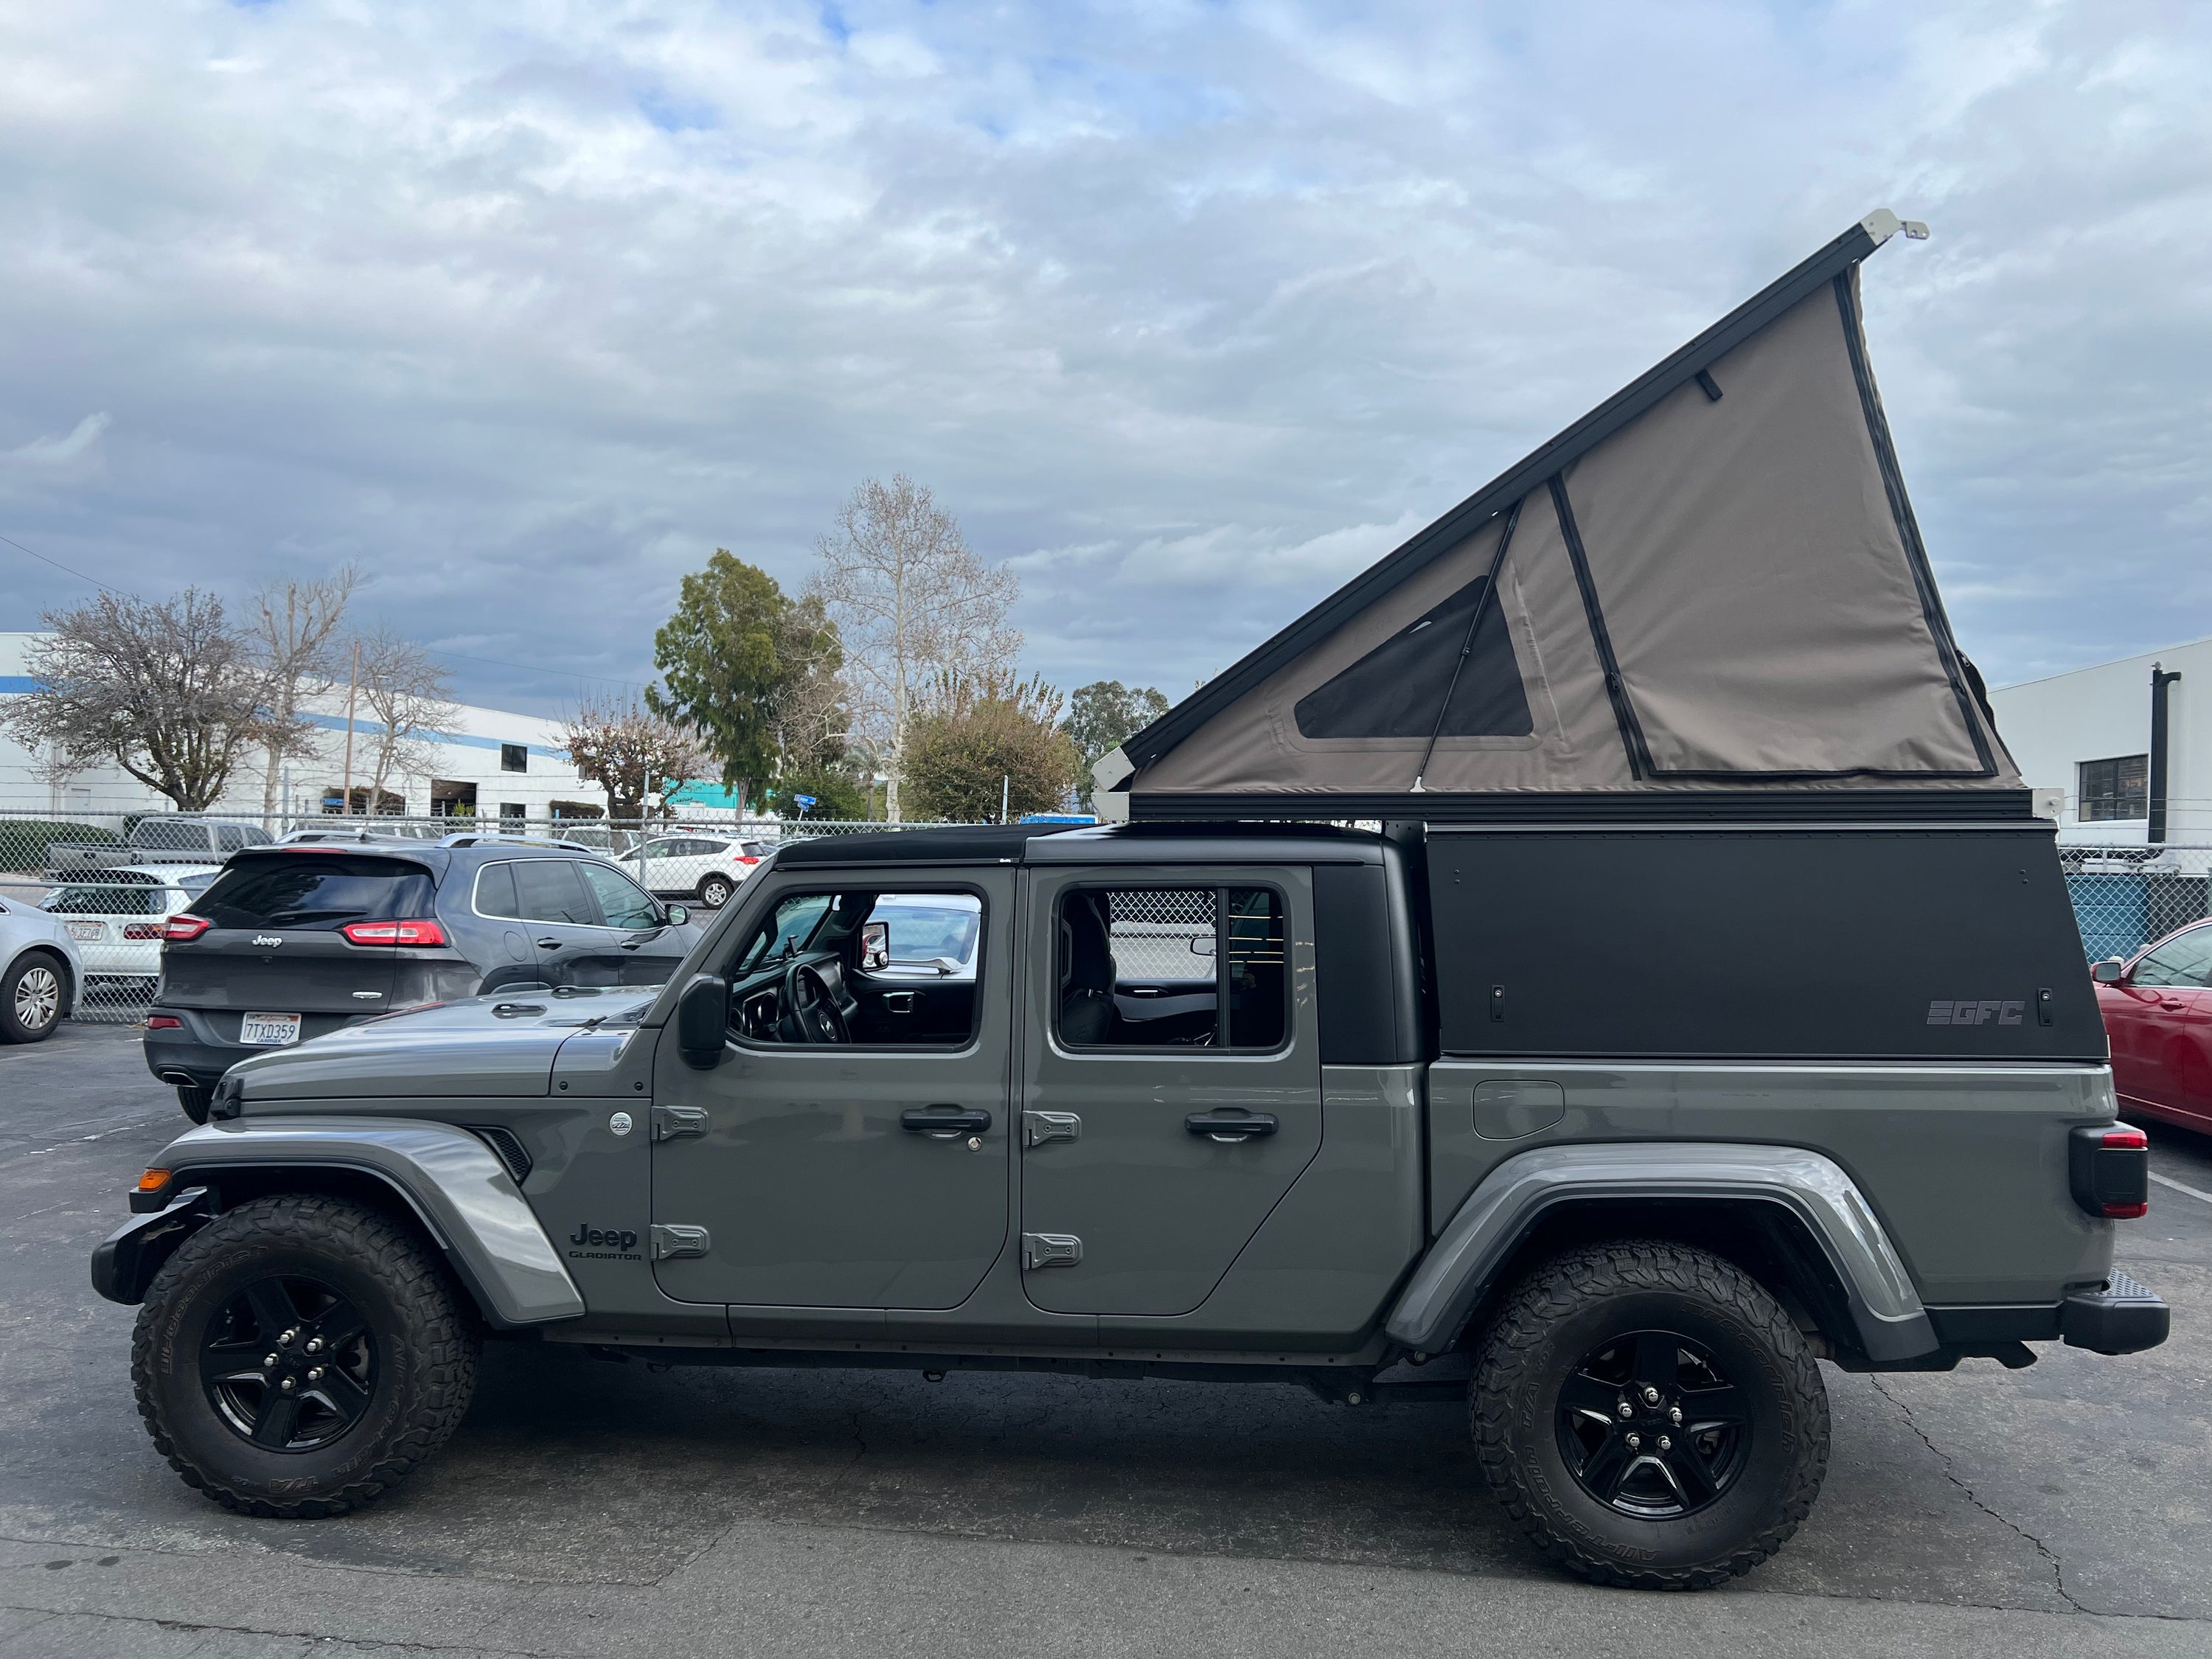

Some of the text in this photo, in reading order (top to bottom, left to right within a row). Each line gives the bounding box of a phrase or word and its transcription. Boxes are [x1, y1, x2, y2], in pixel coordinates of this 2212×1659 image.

[252, 935, 282, 947] Jeep
[247, 1023, 296, 1039] 7TXD359
[570, 1222, 637, 1251] Jeep
[568, 1251, 642, 1261] GLADIATOR
